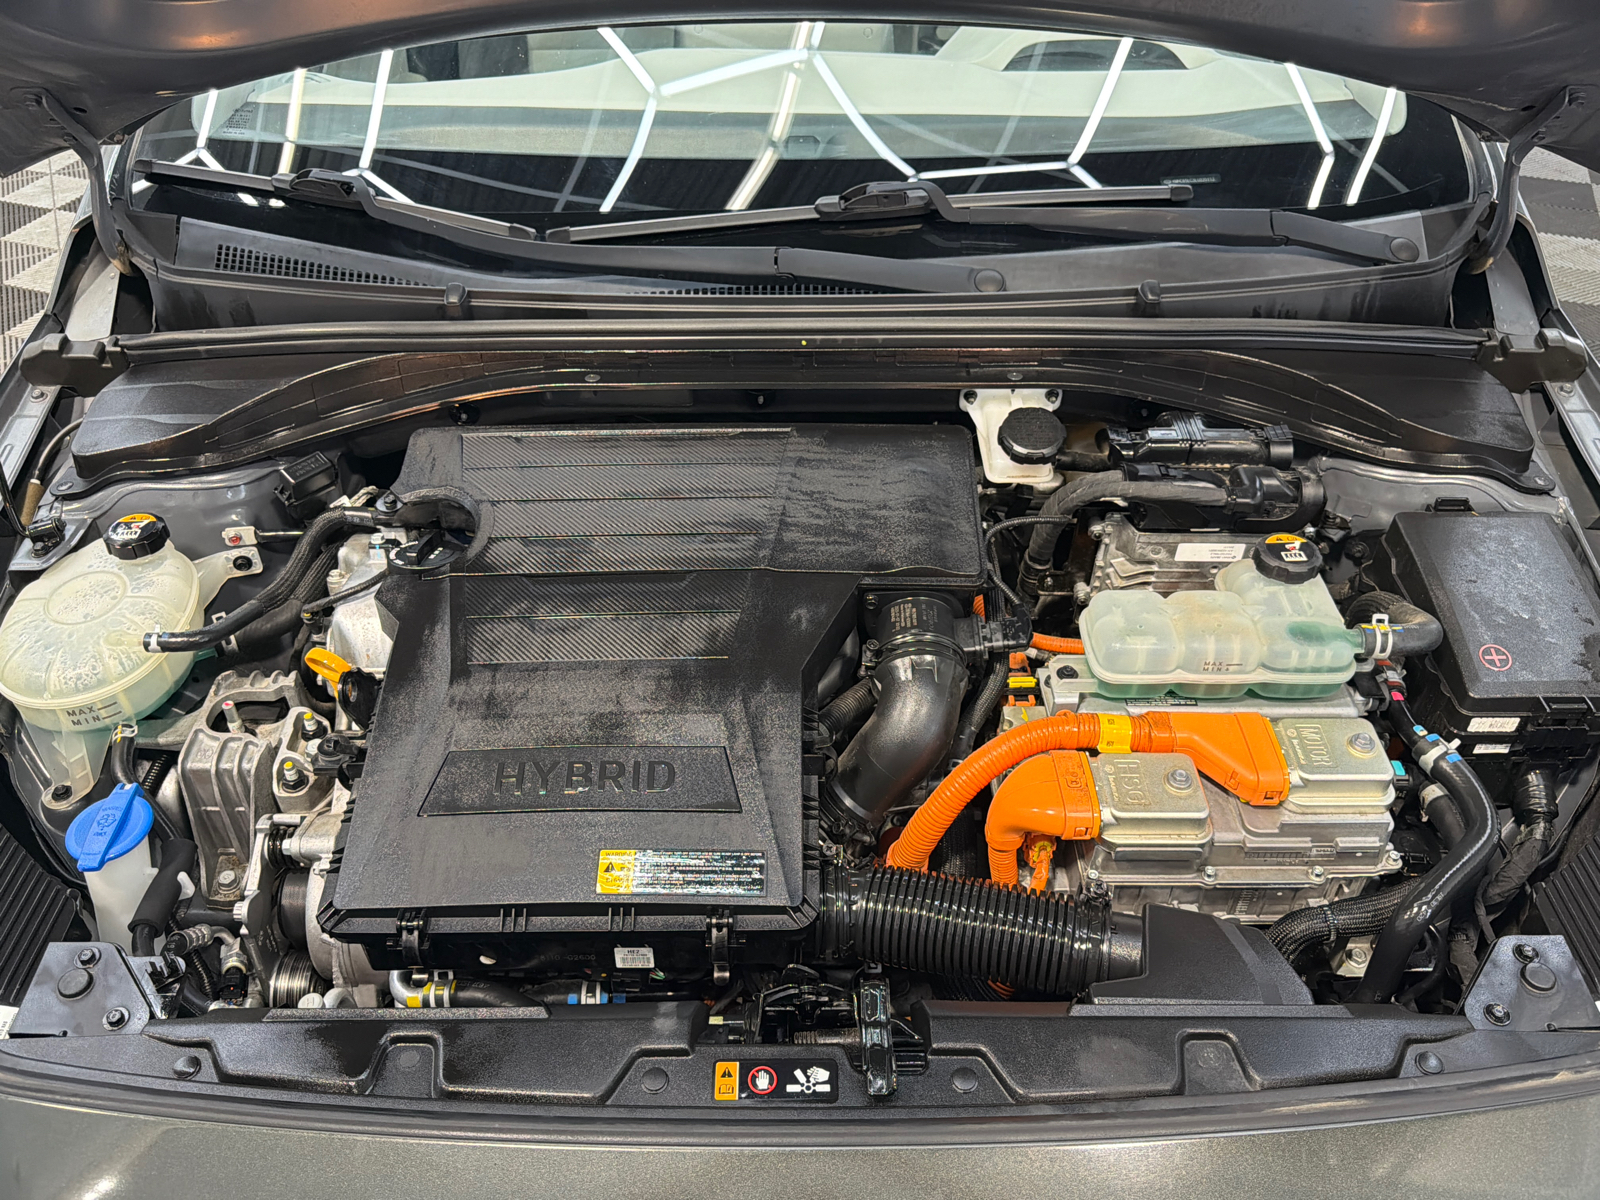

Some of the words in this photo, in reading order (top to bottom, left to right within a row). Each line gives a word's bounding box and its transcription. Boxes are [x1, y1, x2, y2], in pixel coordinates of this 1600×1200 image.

[66, 706, 96, 717] MAX
[71, 715, 101, 726] MIN
[1299, 728, 1333, 766] MOTOR
[495, 760, 676, 795] HYBRID
[1117, 764, 1145, 803] HSG
